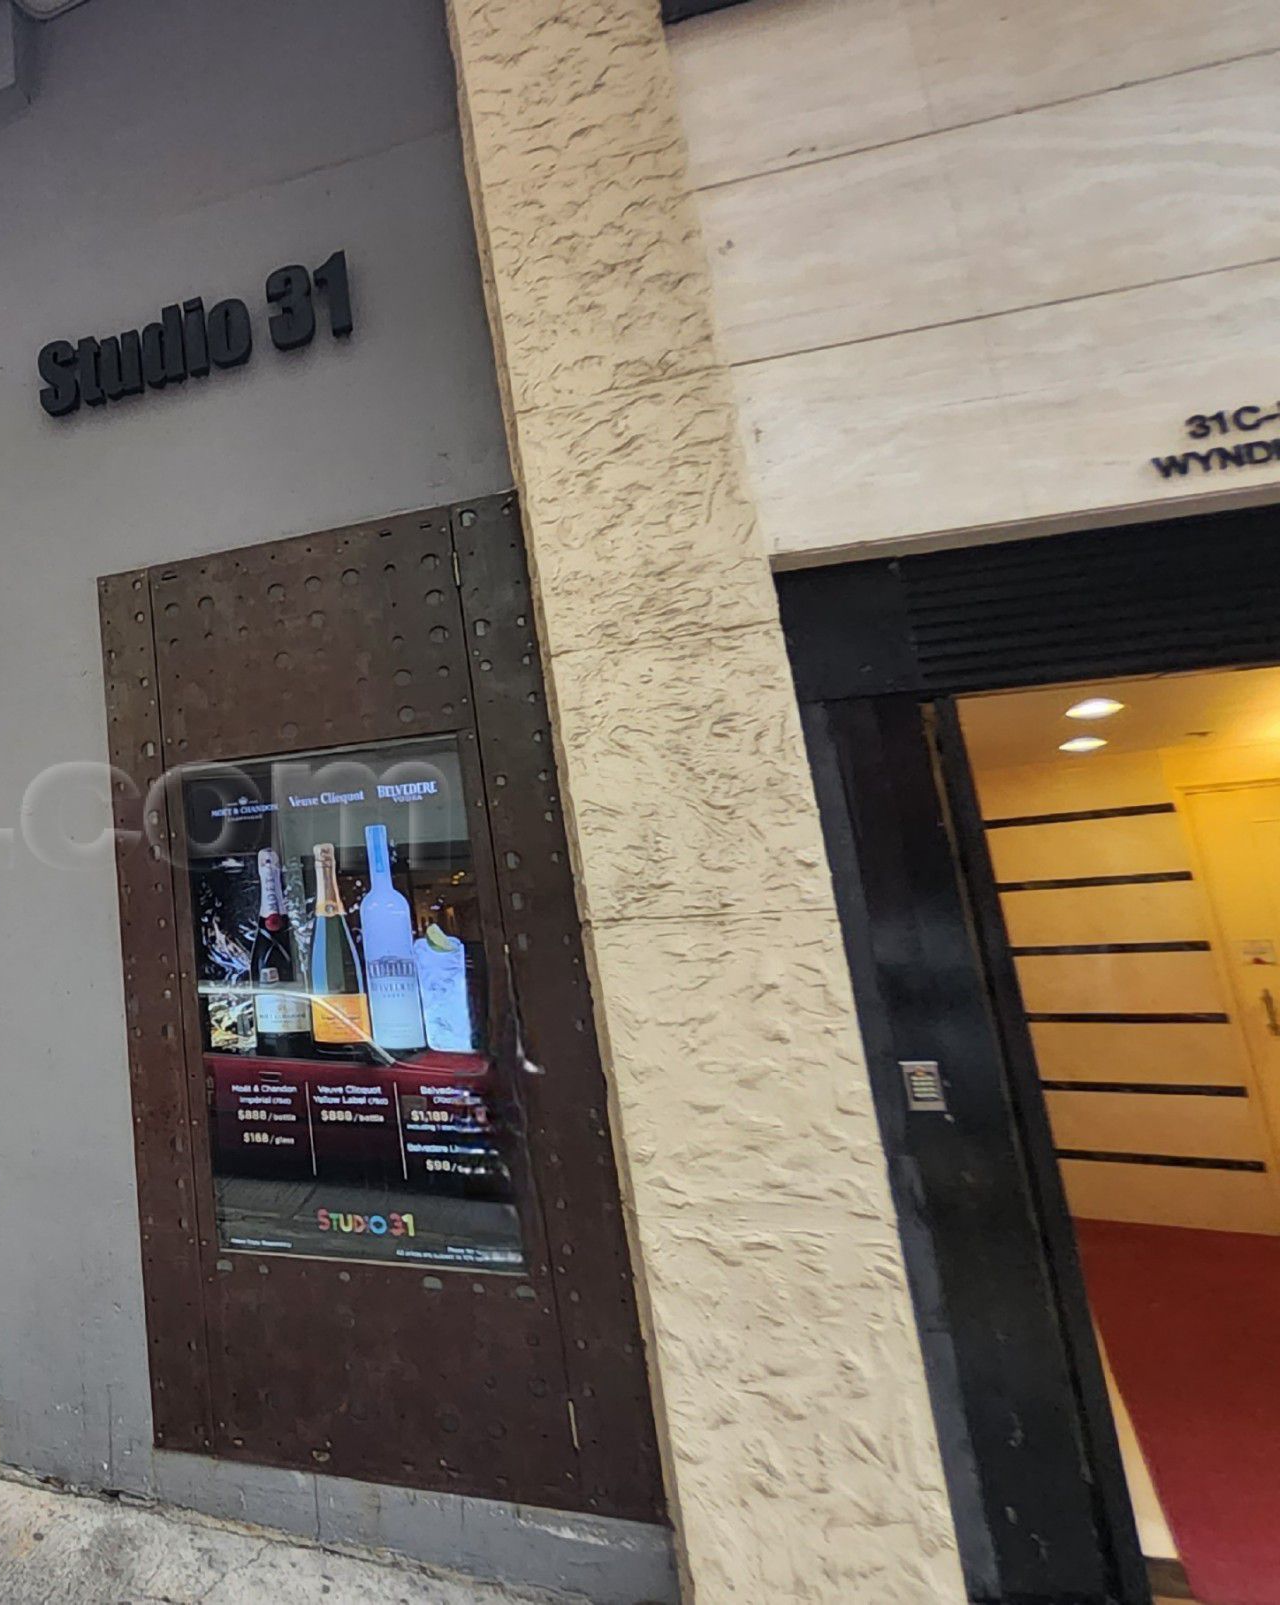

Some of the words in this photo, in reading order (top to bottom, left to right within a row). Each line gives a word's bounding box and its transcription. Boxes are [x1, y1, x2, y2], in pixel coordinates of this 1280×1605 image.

[38, 297, 253, 416] Studio
[266, 249, 353, 351] 31
[376, 781, 438, 799] BELVEDERE
[317, 1208, 388, 1235] STUDIO
[389, 1212, 416, 1237] 31
